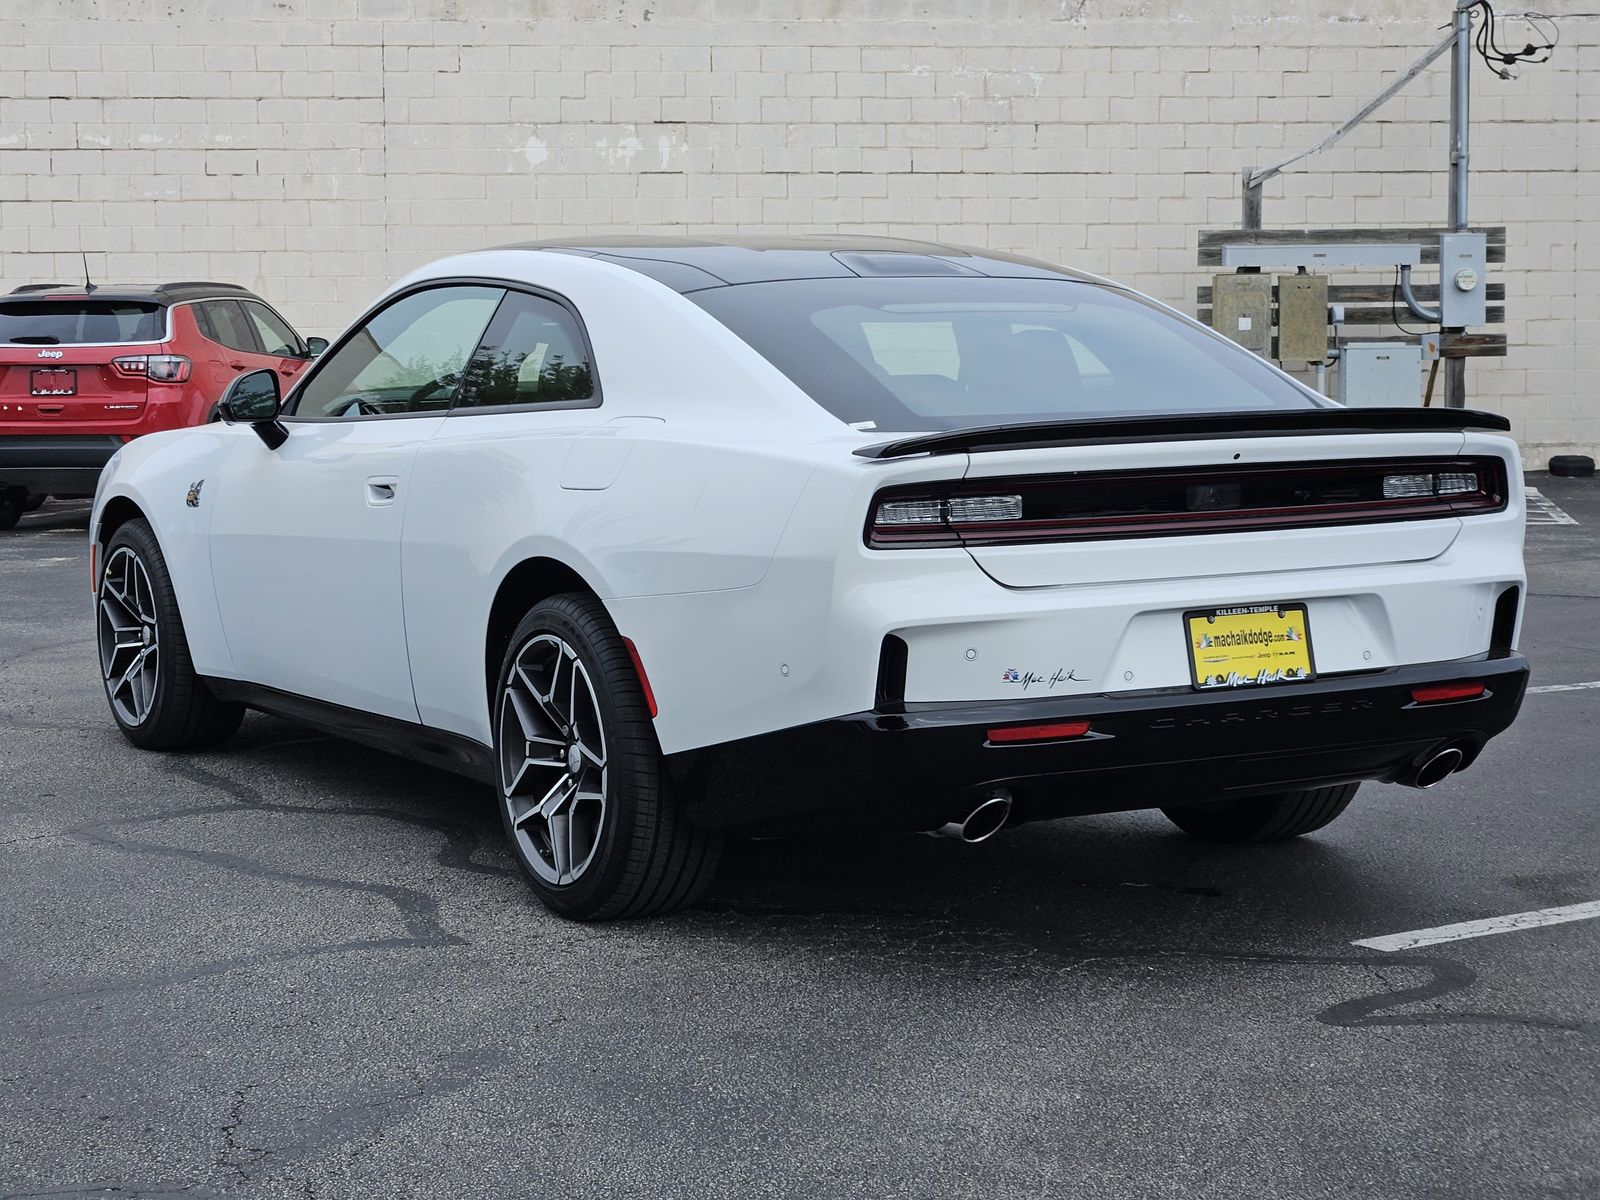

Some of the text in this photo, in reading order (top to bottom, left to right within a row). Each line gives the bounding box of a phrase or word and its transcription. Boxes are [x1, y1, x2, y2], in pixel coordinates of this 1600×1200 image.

[38, 349, 63, 358] Jeep
[1216, 605, 1278, 616] KILLEEN-TEMPLE
[1213, 628, 1285, 648] machaikdodge.com
[1021, 672, 1046, 690] Mac
